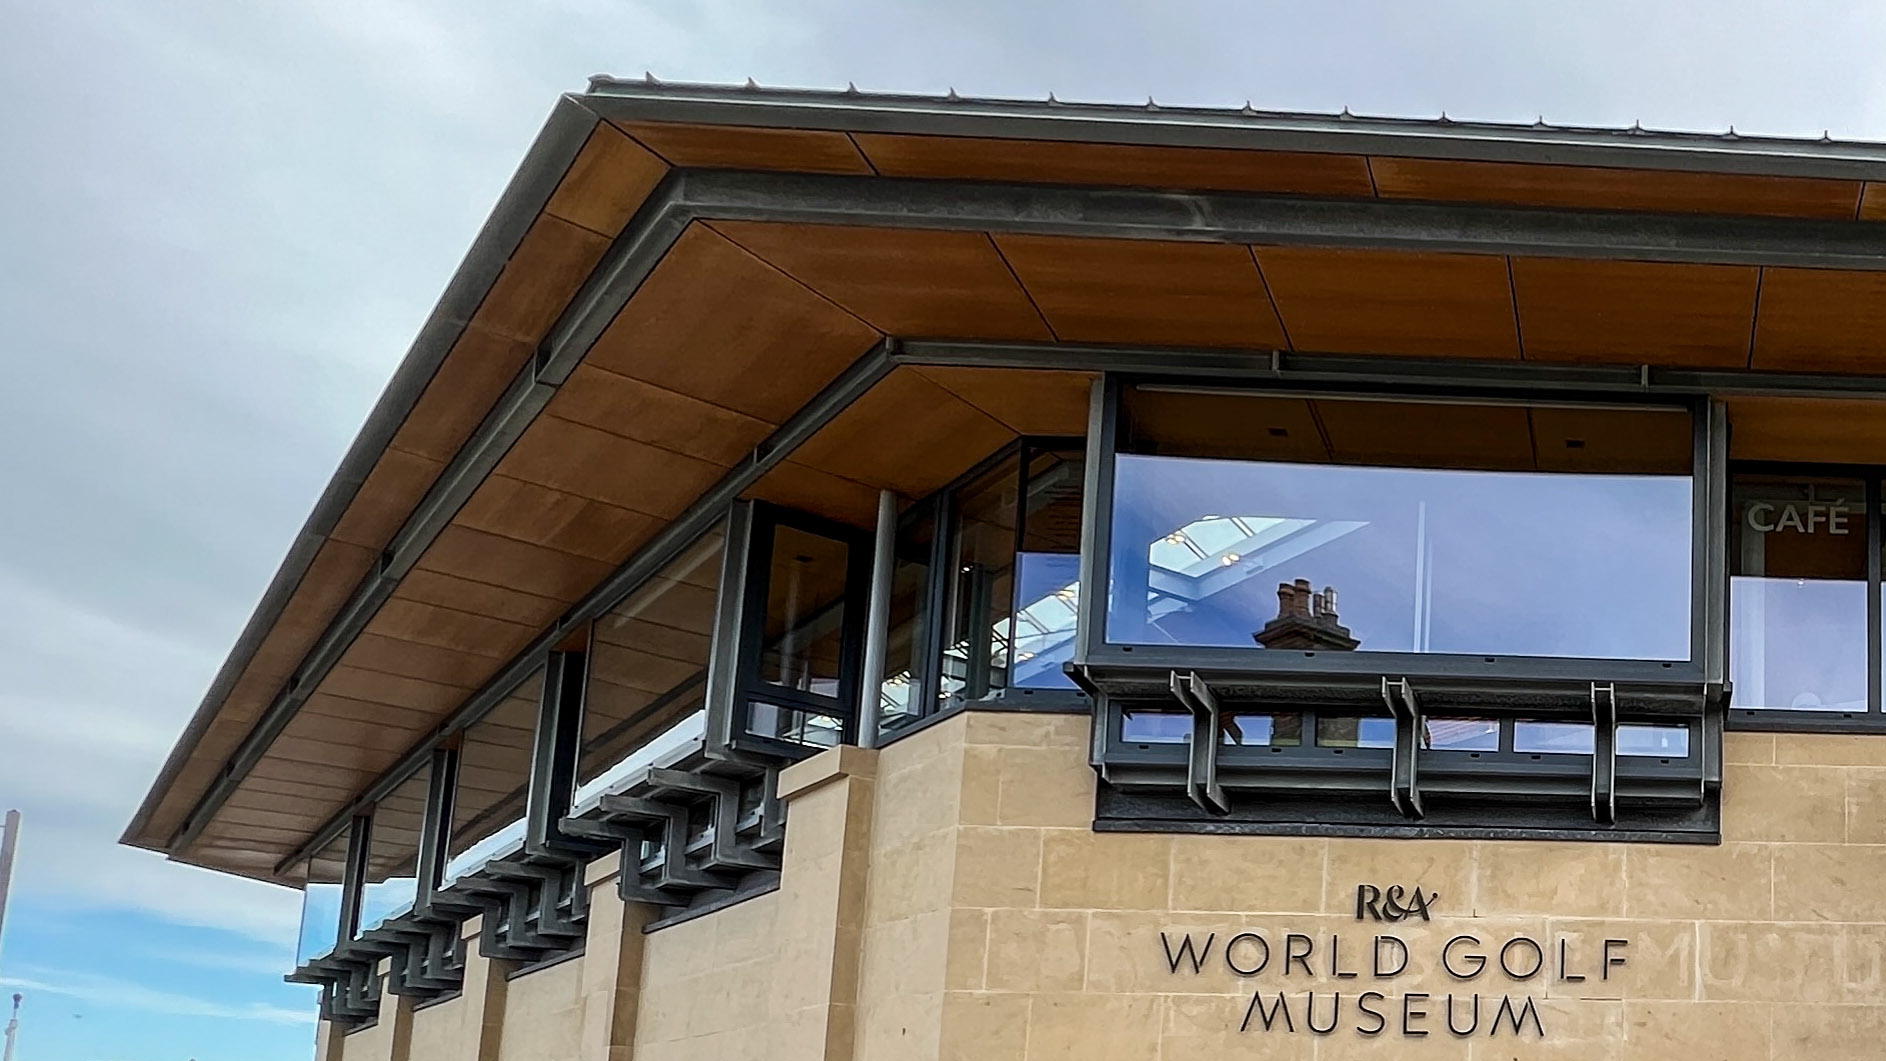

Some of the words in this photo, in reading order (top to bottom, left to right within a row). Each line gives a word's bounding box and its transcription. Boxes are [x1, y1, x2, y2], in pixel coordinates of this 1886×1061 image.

[1748, 498, 1849, 535] CAFÉ
[1356, 884, 1439, 922] R&A
[1160, 932, 1409, 978] WORLD
[1442, 935, 1629, 981] GOLF
[1240, 991, 1544, 1037] MUSEUM
